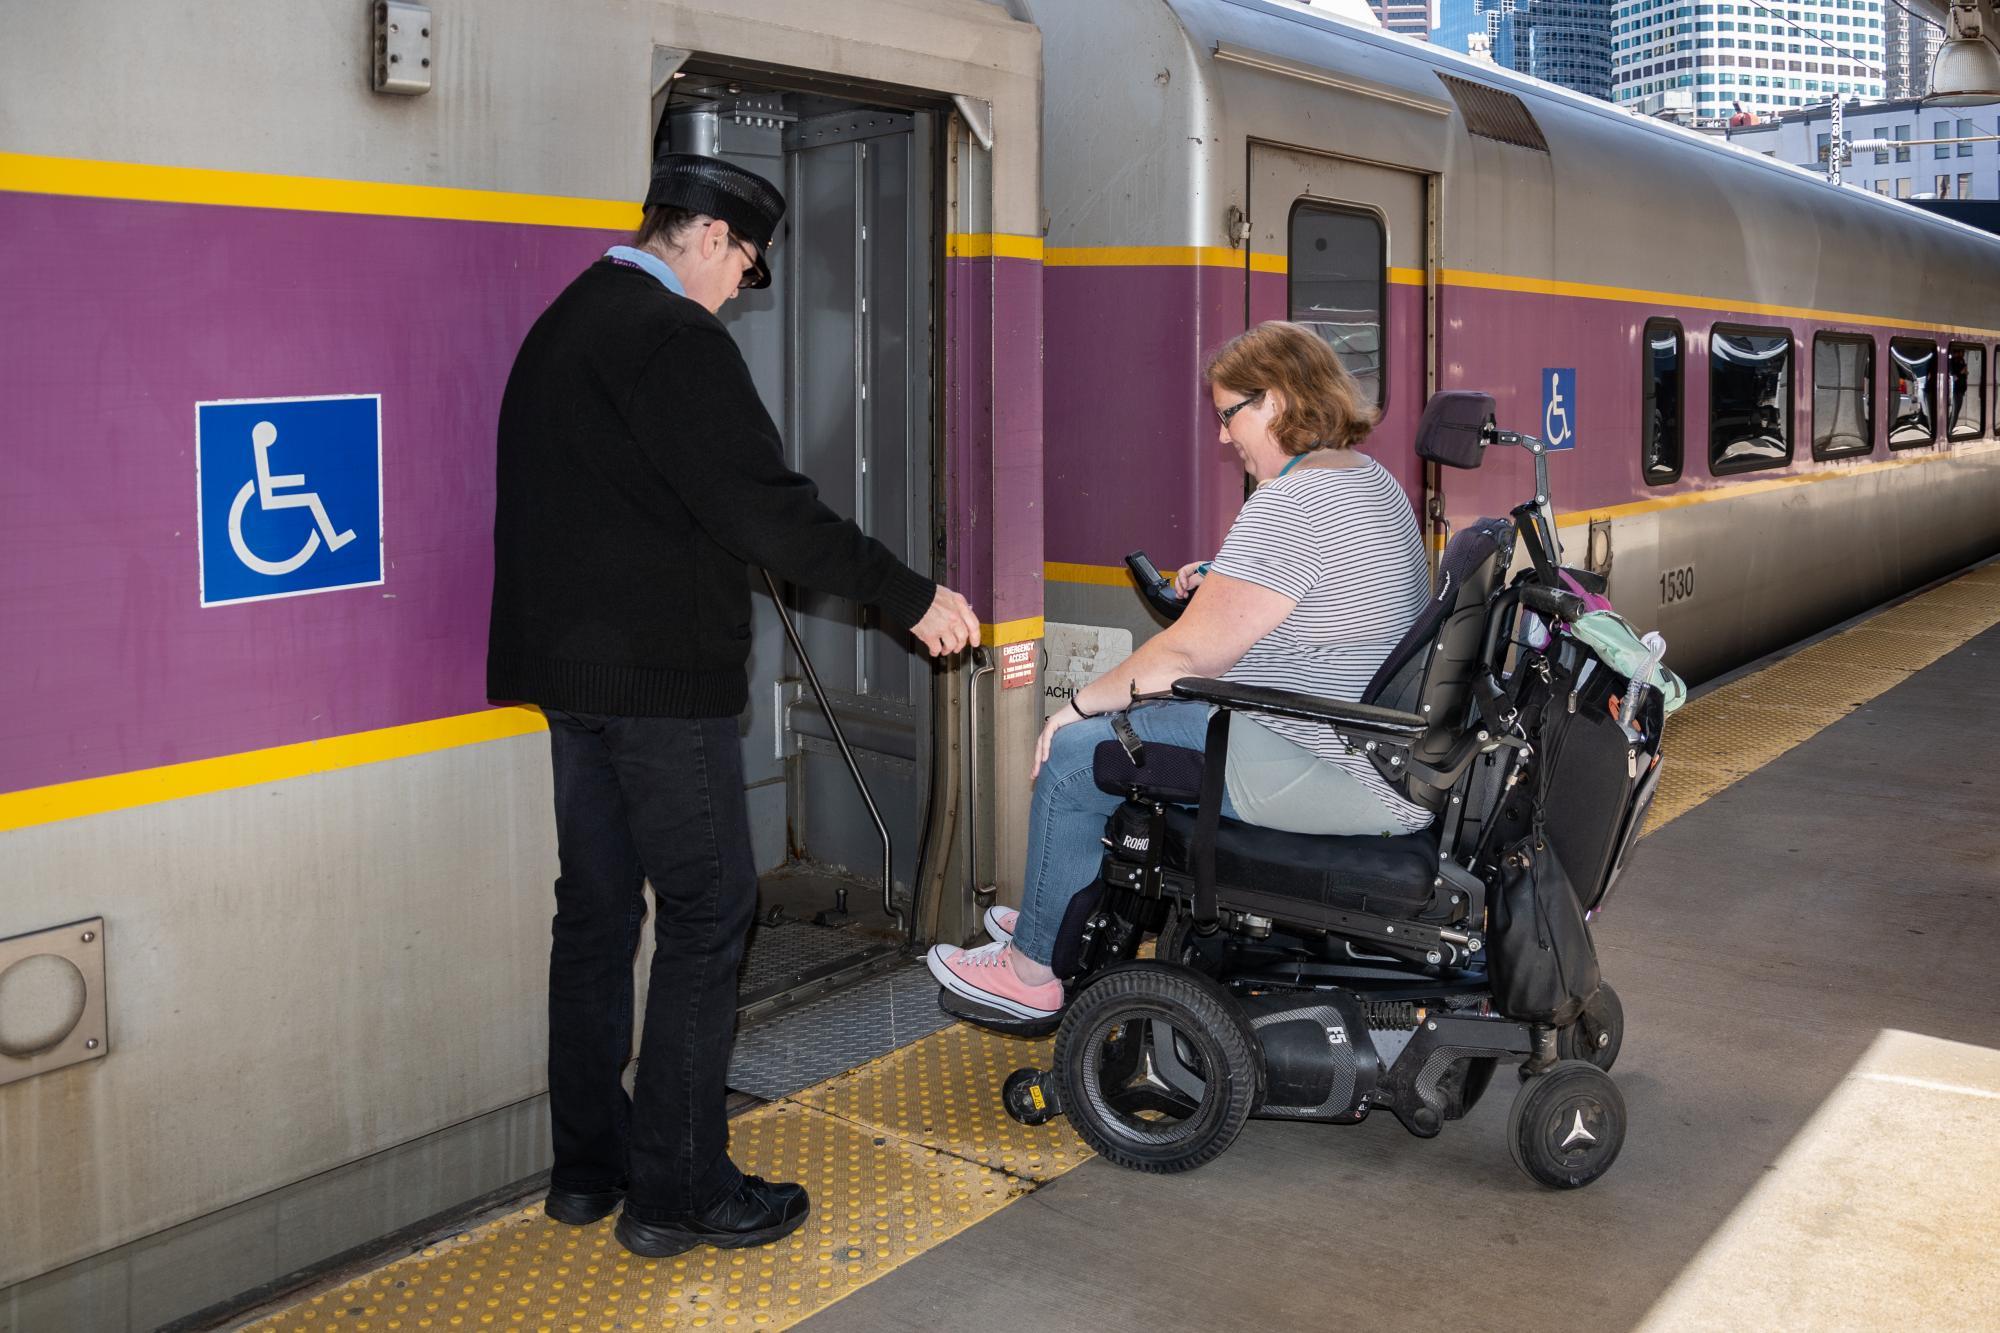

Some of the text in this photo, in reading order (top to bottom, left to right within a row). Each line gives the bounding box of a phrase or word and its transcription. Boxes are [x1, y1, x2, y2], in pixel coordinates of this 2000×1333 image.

[1660, 566, 1694, 605] 1530
[1003, 641, 1035, 656] EMERGENCY
[1009, 652, 1029, 664] ACCESS
[1123, 834, 1149, 851] ROHO
[1326, 1026, 1347, 1044] F5
